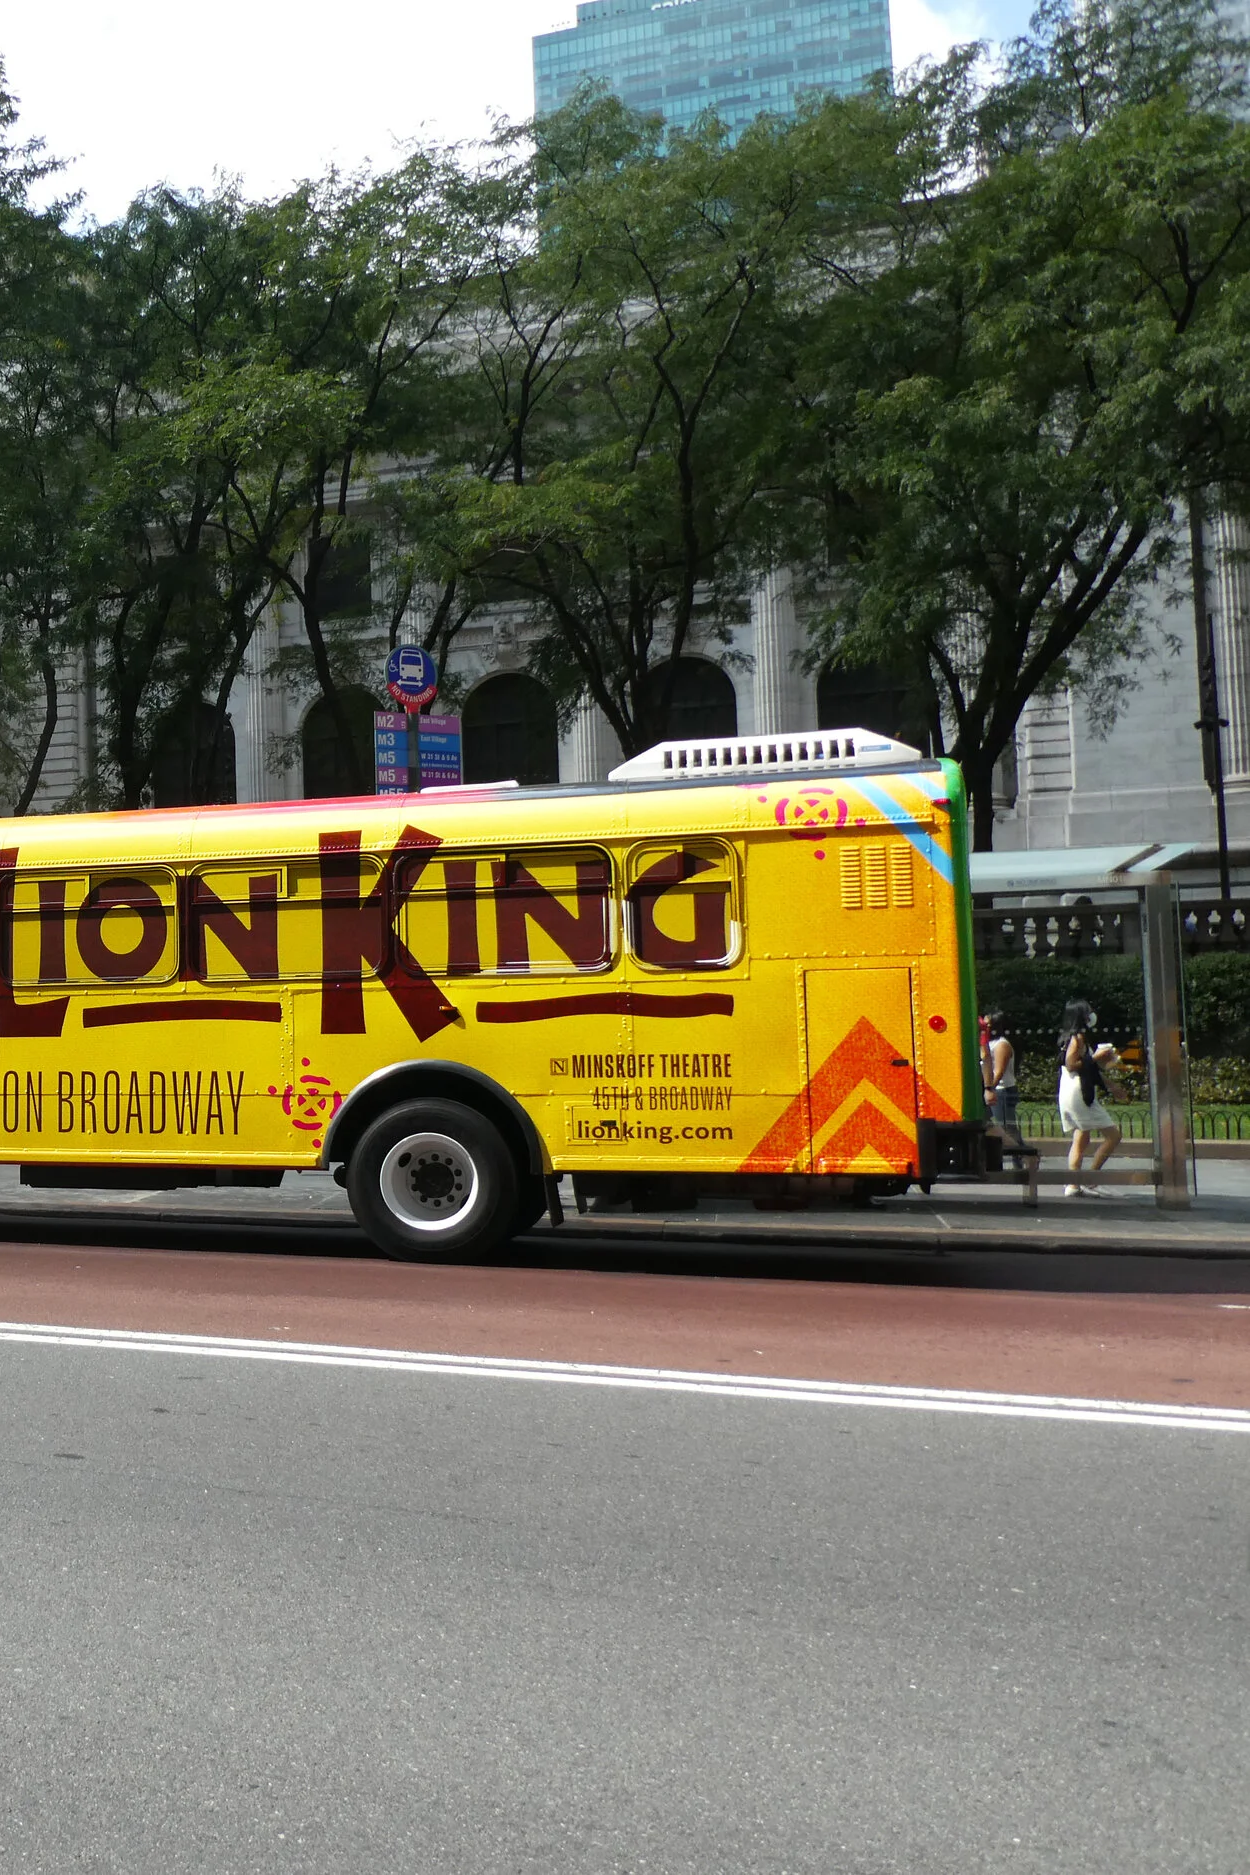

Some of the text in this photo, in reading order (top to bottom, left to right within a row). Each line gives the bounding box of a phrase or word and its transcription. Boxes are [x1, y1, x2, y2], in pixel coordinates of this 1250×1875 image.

[392, 685, 433, 703] NO STANDING
[377, 715, 394, 728] M2
[378, 733, 395, 746] M3
[378, 751, 396, 764] M5
[378, 769, 396, 782] M5
[319, 824, 727, 1043] KING
[552, 1053, 732, 1078] N MINSKOFF THEATRE
[3, 1070, 43, 1133] ON
[57, 1070, 245, 1136] BROADWAY
[592, 1086, 733, 1111] 45TH & BROADWAY
[577, 1120, 733, 1144] lionking.com
